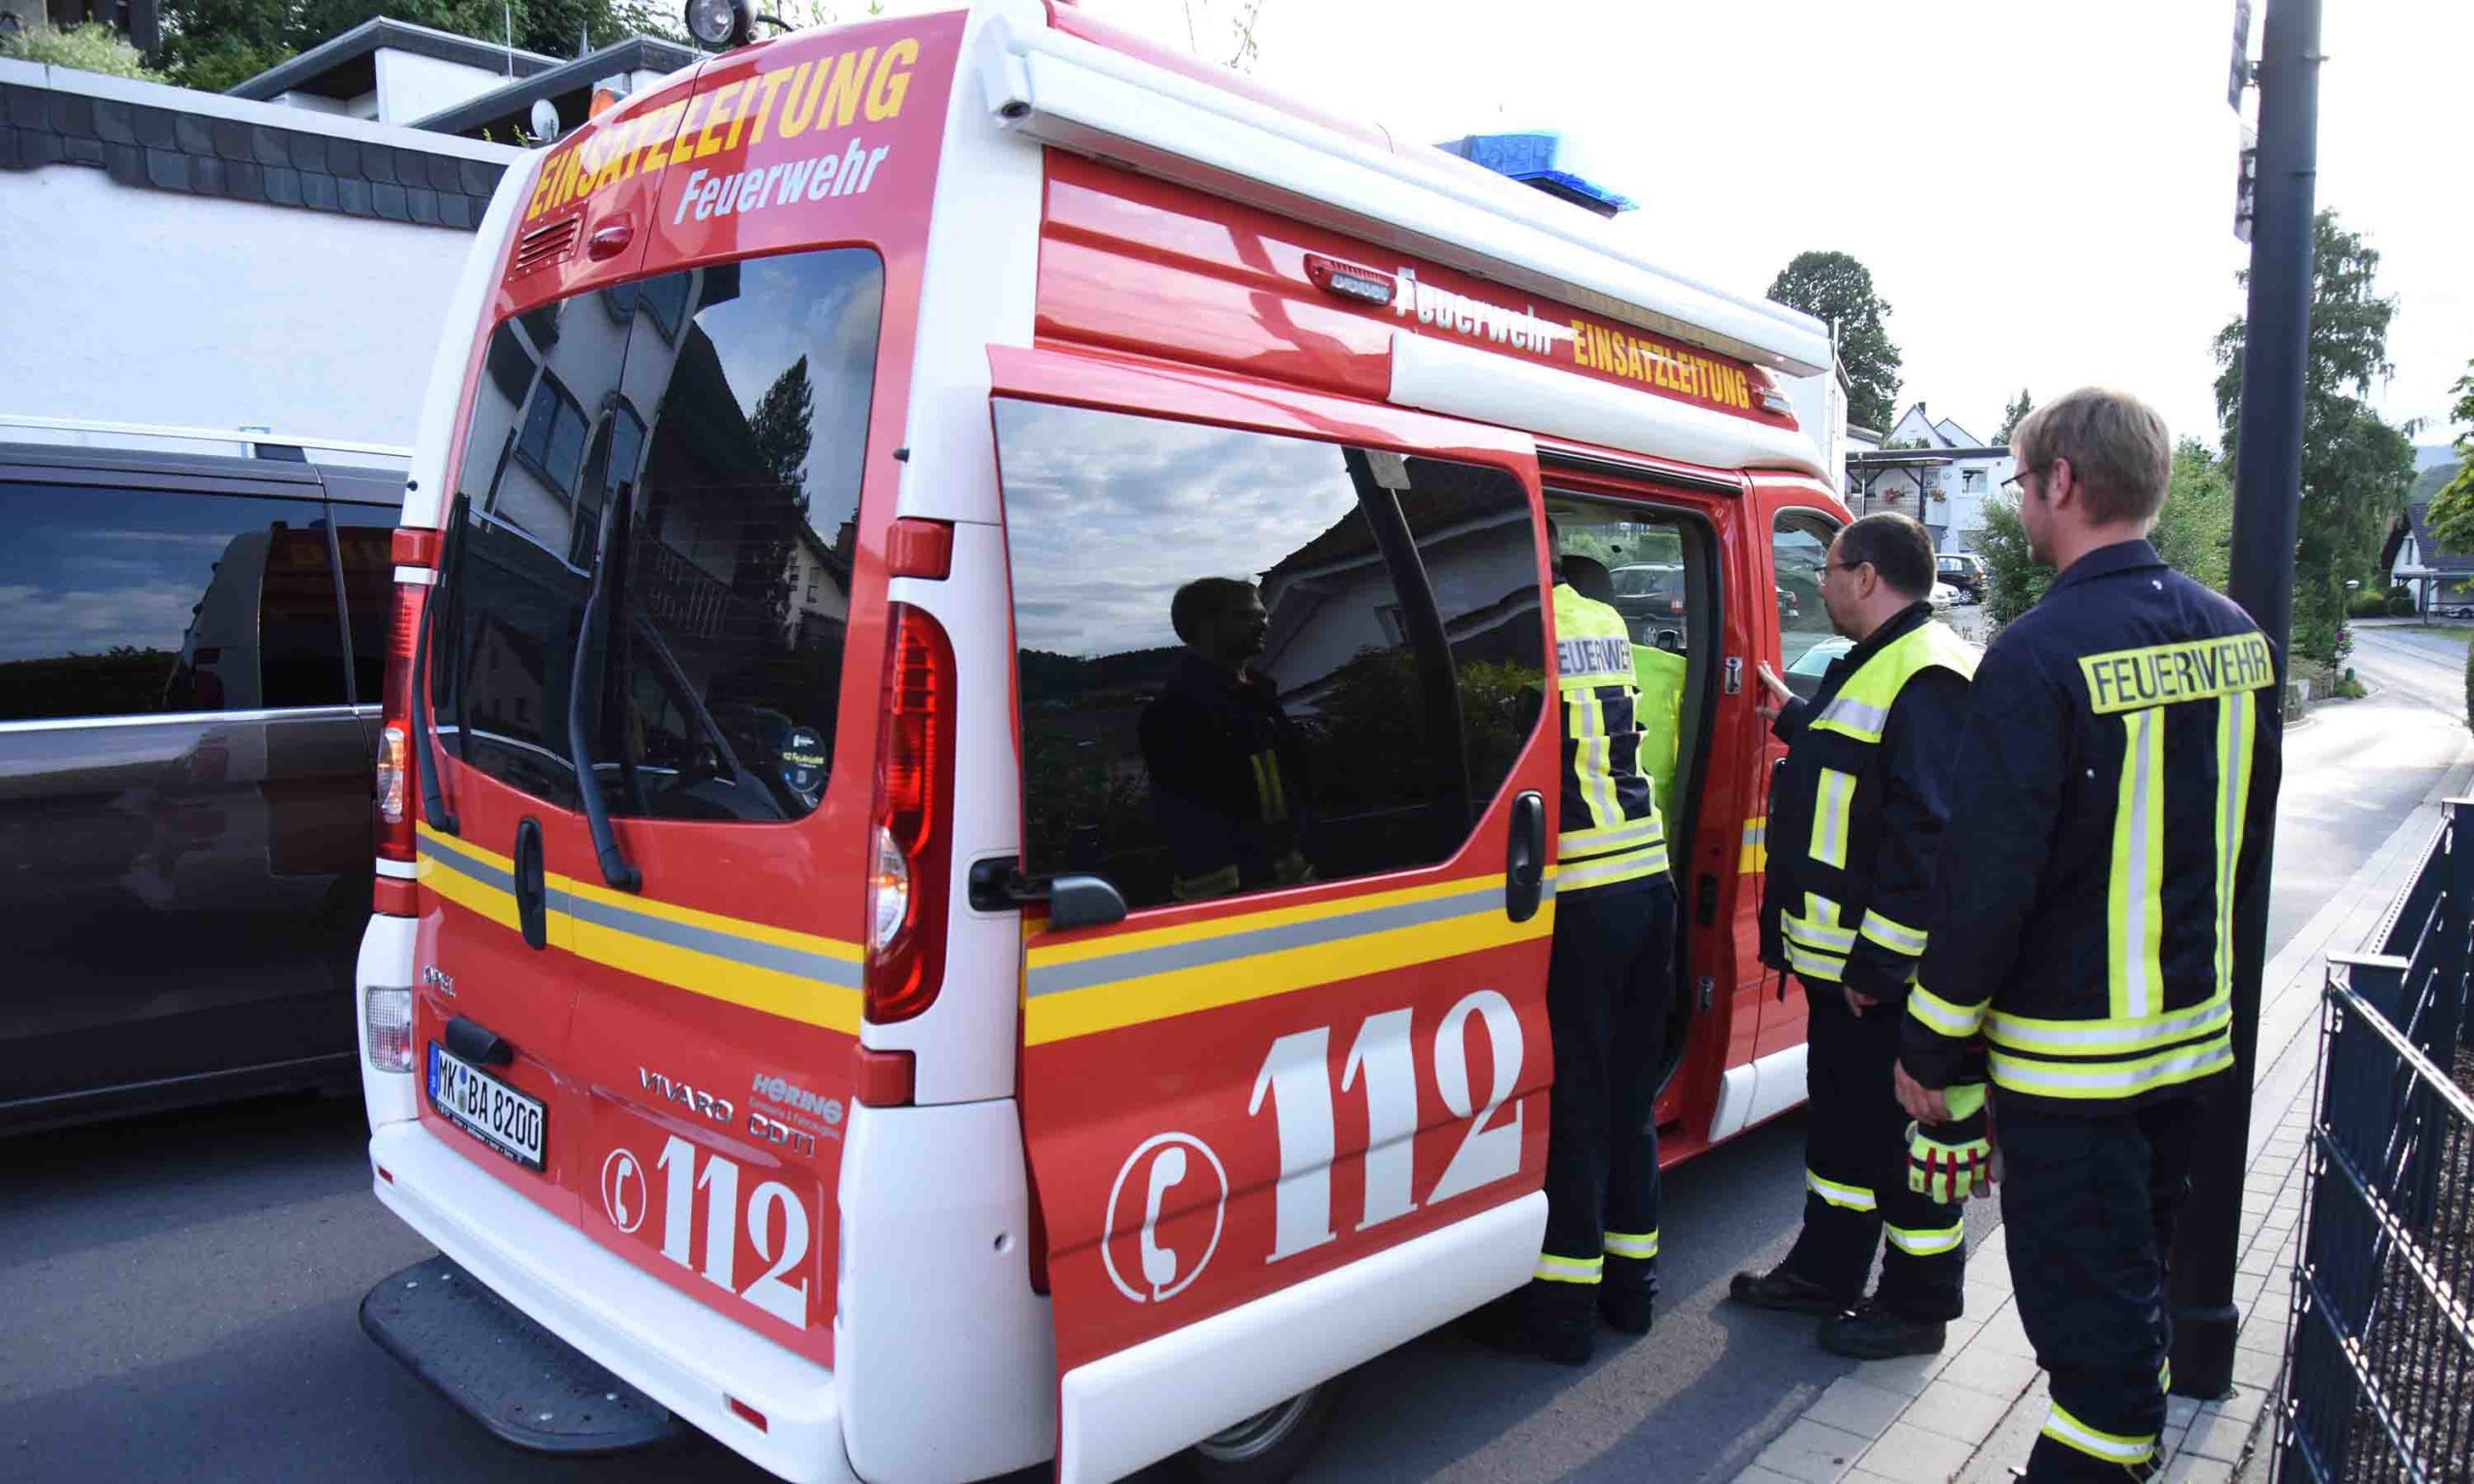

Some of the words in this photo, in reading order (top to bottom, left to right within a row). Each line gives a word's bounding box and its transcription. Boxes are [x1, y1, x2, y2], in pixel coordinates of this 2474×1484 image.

[527, 38, 920, 221] EINSATZLEITUNG
[674, 137, 890, 225] Feuerwehr
[1395, 267, 1551, 356] Feuerwehr
[1571, 320, 1750, 410] EINSATZLEITUNG
[1557, 639, 1629, 674] EUERWE
[2091, 640, 2268, 706] FEUERWEHR
[438, 1051, 458, 1103] MK
[468, 1074, 488, 1125] BA
[493, 1090, 539, 1152] 8200
[639, 1066, 734, 1123] VIVARO
[1248, 989, 1524, 1265] 112
[657, 1134, 809, 1331] 112
